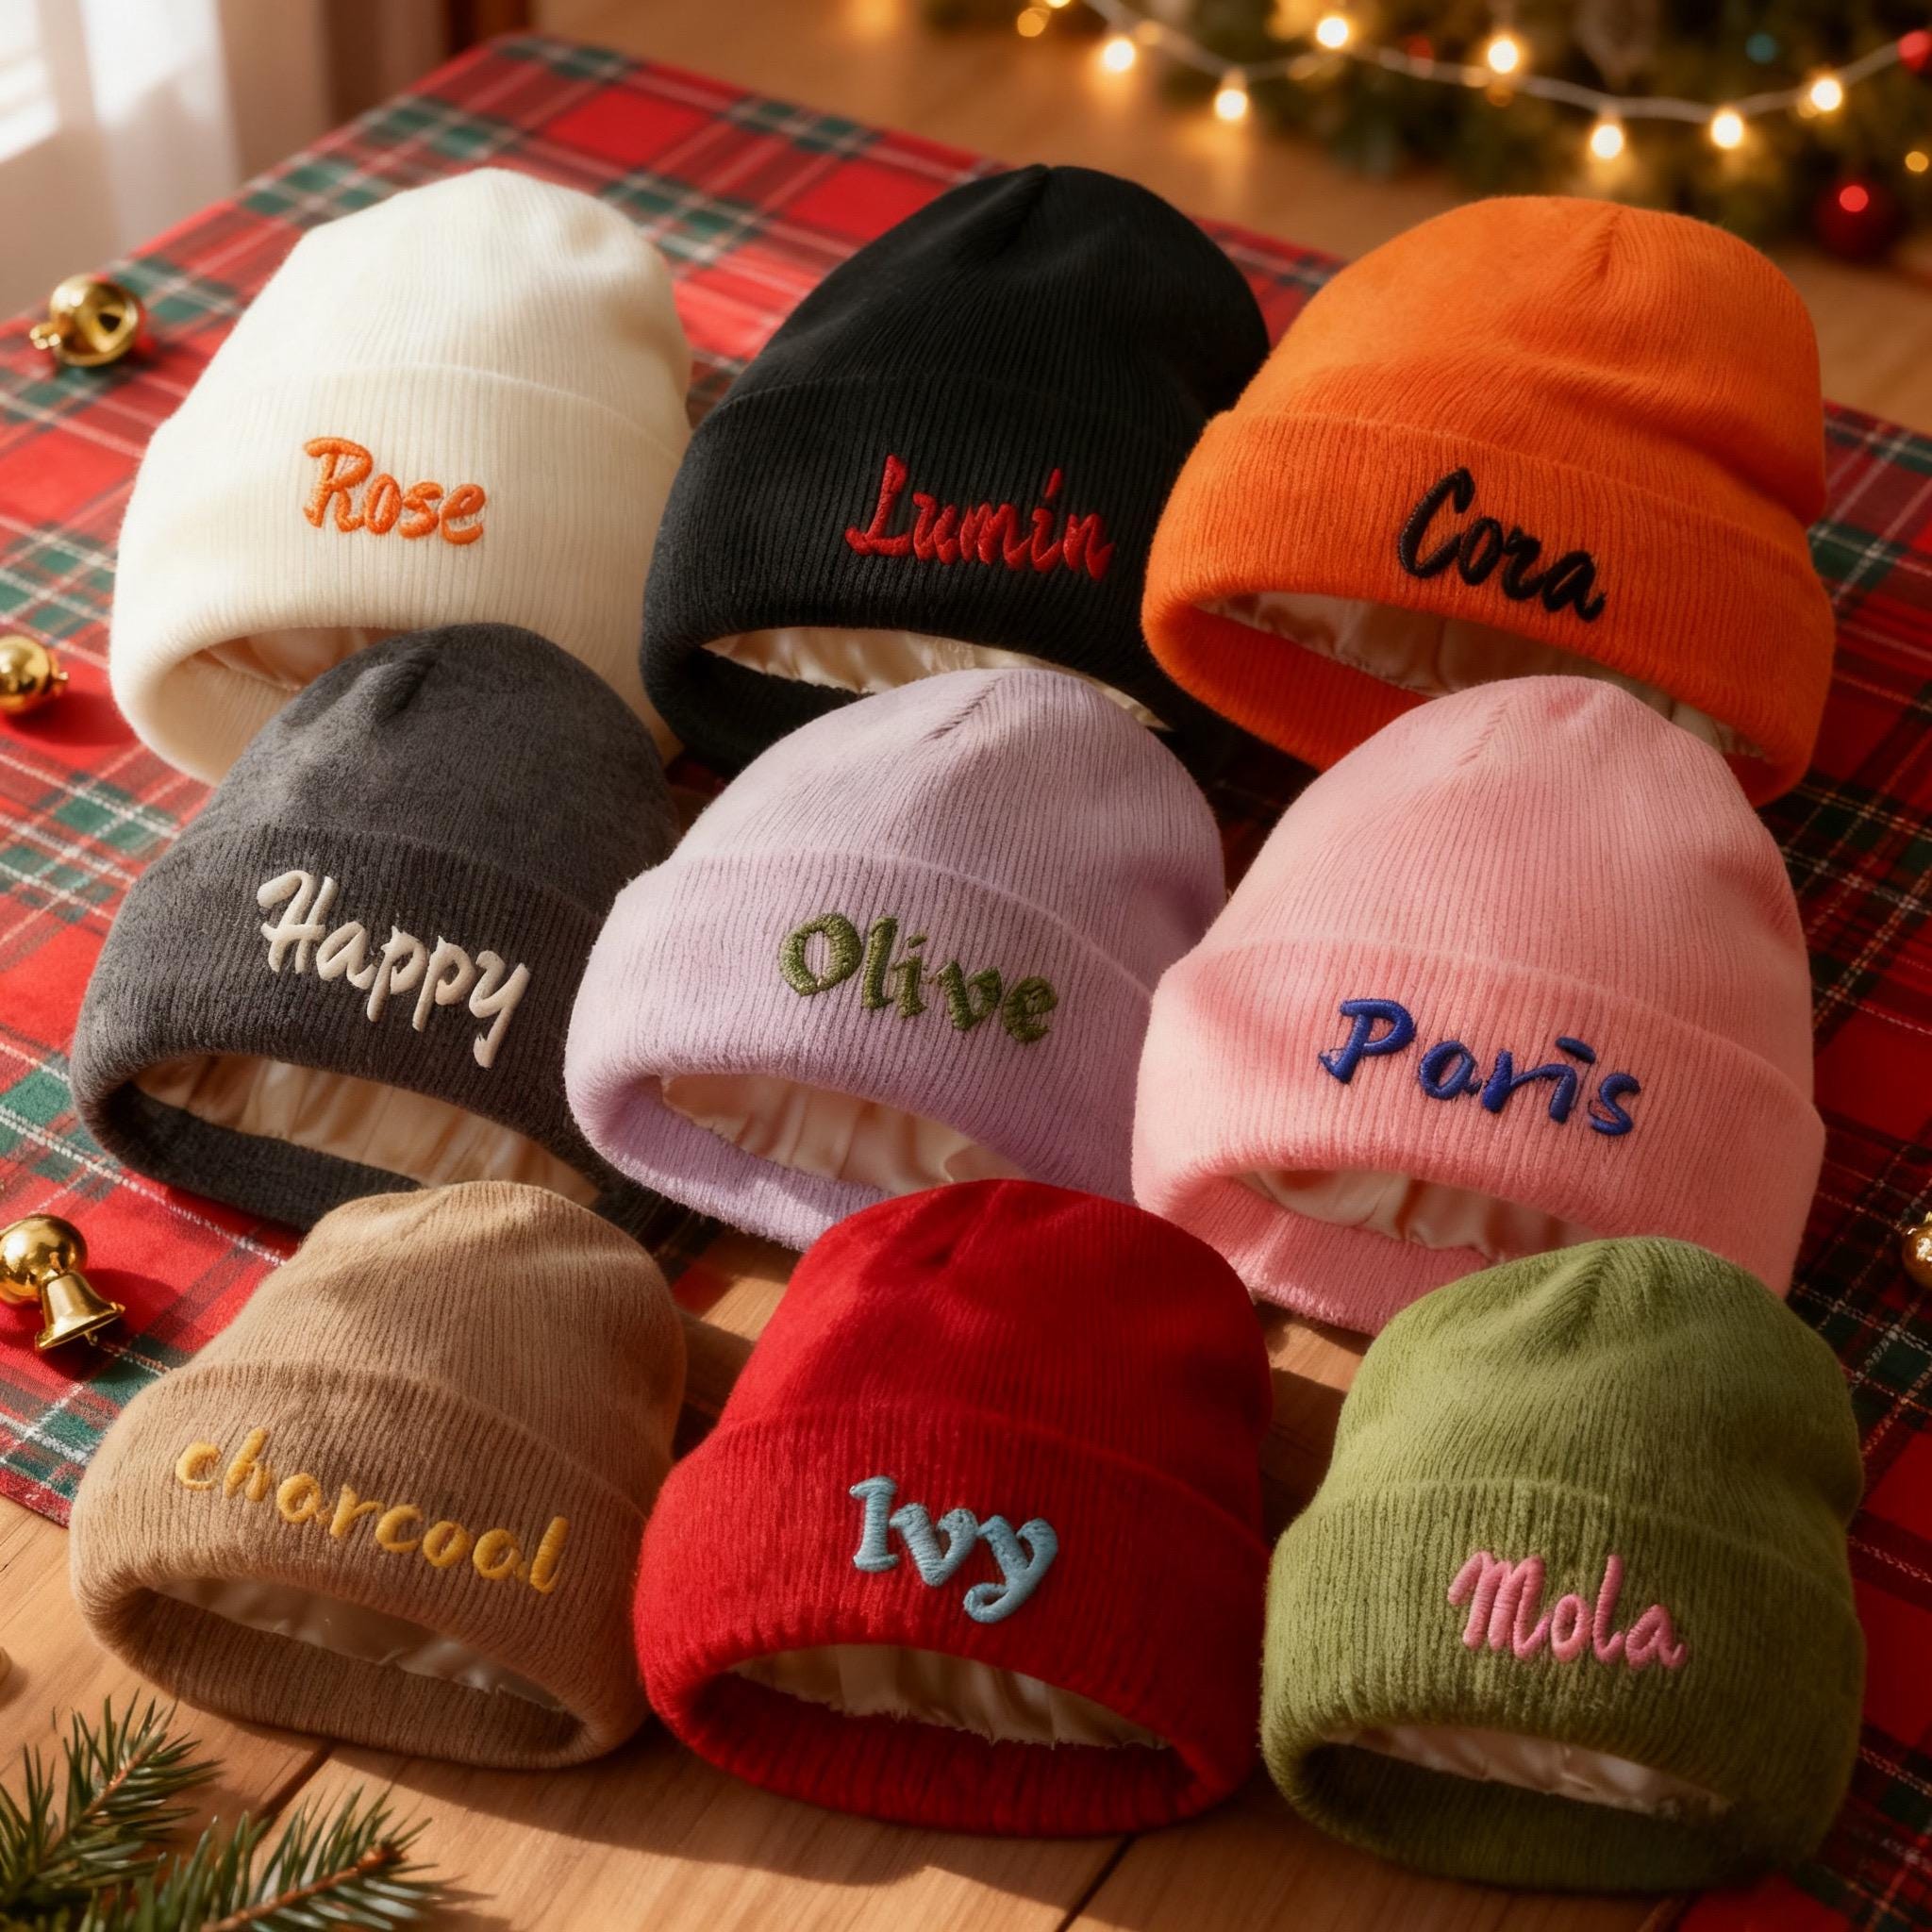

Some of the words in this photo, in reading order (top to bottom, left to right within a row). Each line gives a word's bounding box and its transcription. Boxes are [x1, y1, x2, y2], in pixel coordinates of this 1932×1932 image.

[304, 438, 487, 543] Rose
[845, 455, 1114, 579] Lumin
[1399, 468, 1606, 621] Cora
[257, 869, 529, 1068] Happy
[779, 912, 1058, 1044] Olive
[1319, 998, 1641, 1136] Paris
[850, 1475, 1058, 1624] Ivy
[1448, 1551, 1687, 1669] Mola
